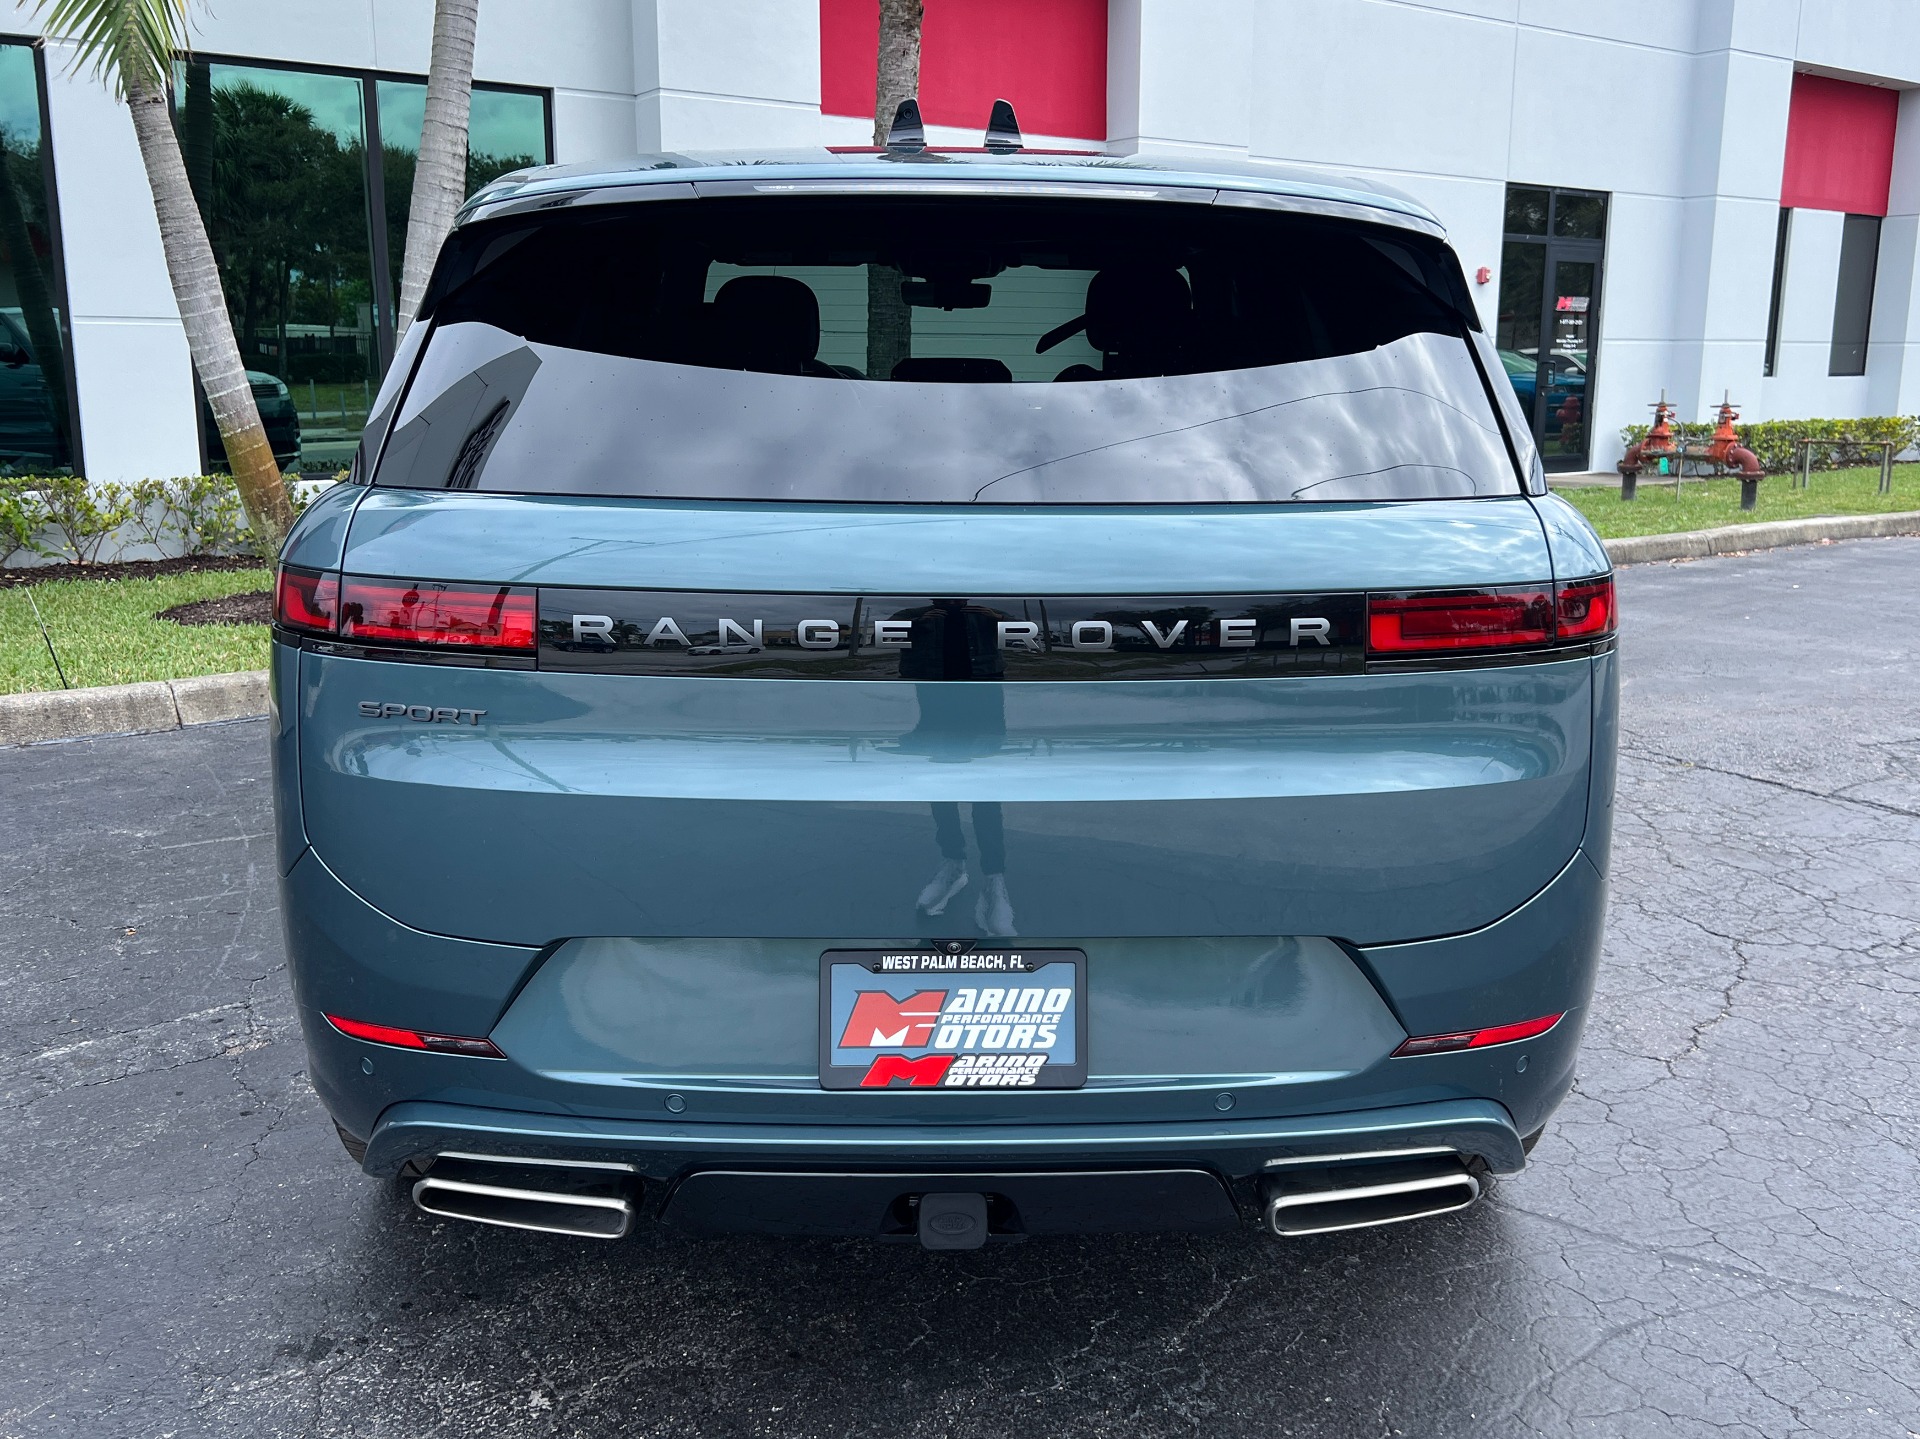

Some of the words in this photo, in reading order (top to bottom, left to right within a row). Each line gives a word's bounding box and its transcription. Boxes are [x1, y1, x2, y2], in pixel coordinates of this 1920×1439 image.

[572, 614, 912, 649] RANGE
[997, 617, 1331, 650] ROVER
[358, 701, 488, 725] SPORT
[882, 955, 918, 970] WEST
[920, 955, 957, 970] PALM
[960, 955, 1006, 971] BEACH,
[1009, 955, 1025, 969] FL
[940, 1014, 1062, 1024] PERFORMANCE
[948, 1067, 1041, 1075] PERFORMANCE
